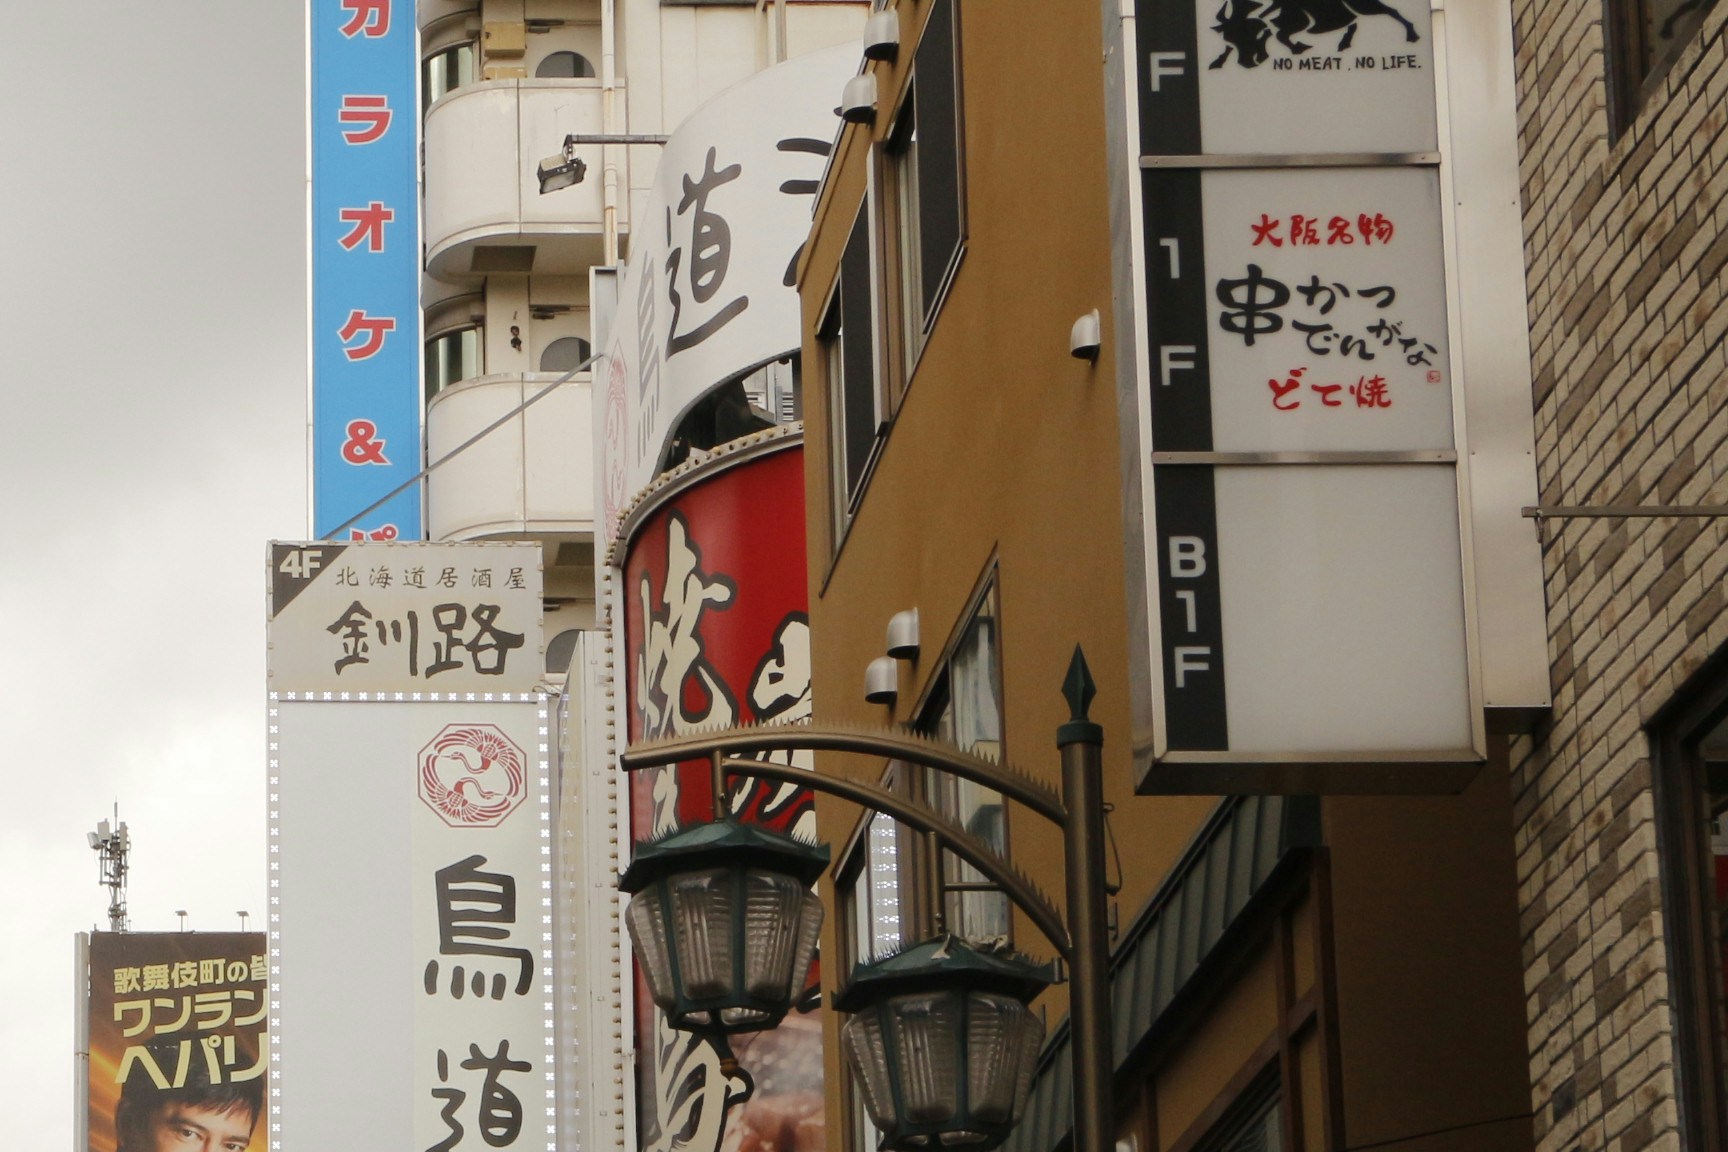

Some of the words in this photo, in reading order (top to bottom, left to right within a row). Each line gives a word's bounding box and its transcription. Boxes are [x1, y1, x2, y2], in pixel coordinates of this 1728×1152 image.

[1273, 58, 1293, 70] NO
[1298, 57, 1341, 70] MEAT
[1355, 57, 1375, 69] NO
[1382, 55, 1421, 70] LIFE.
[1251, 213, 1394, 247] 大阪名物
[1216, 264, 1397, 347] 串かつ
[1292, 319, 1438, 366] でんがな
[1268, 367, 1392, 410] どて焼
[279, 552, 322, 579] 4F
[336, 565, 528, 591] 北海道居酒屋
[1169, 536, 1210, 689] B1F
[326, 600, 525, 679] 釧路
